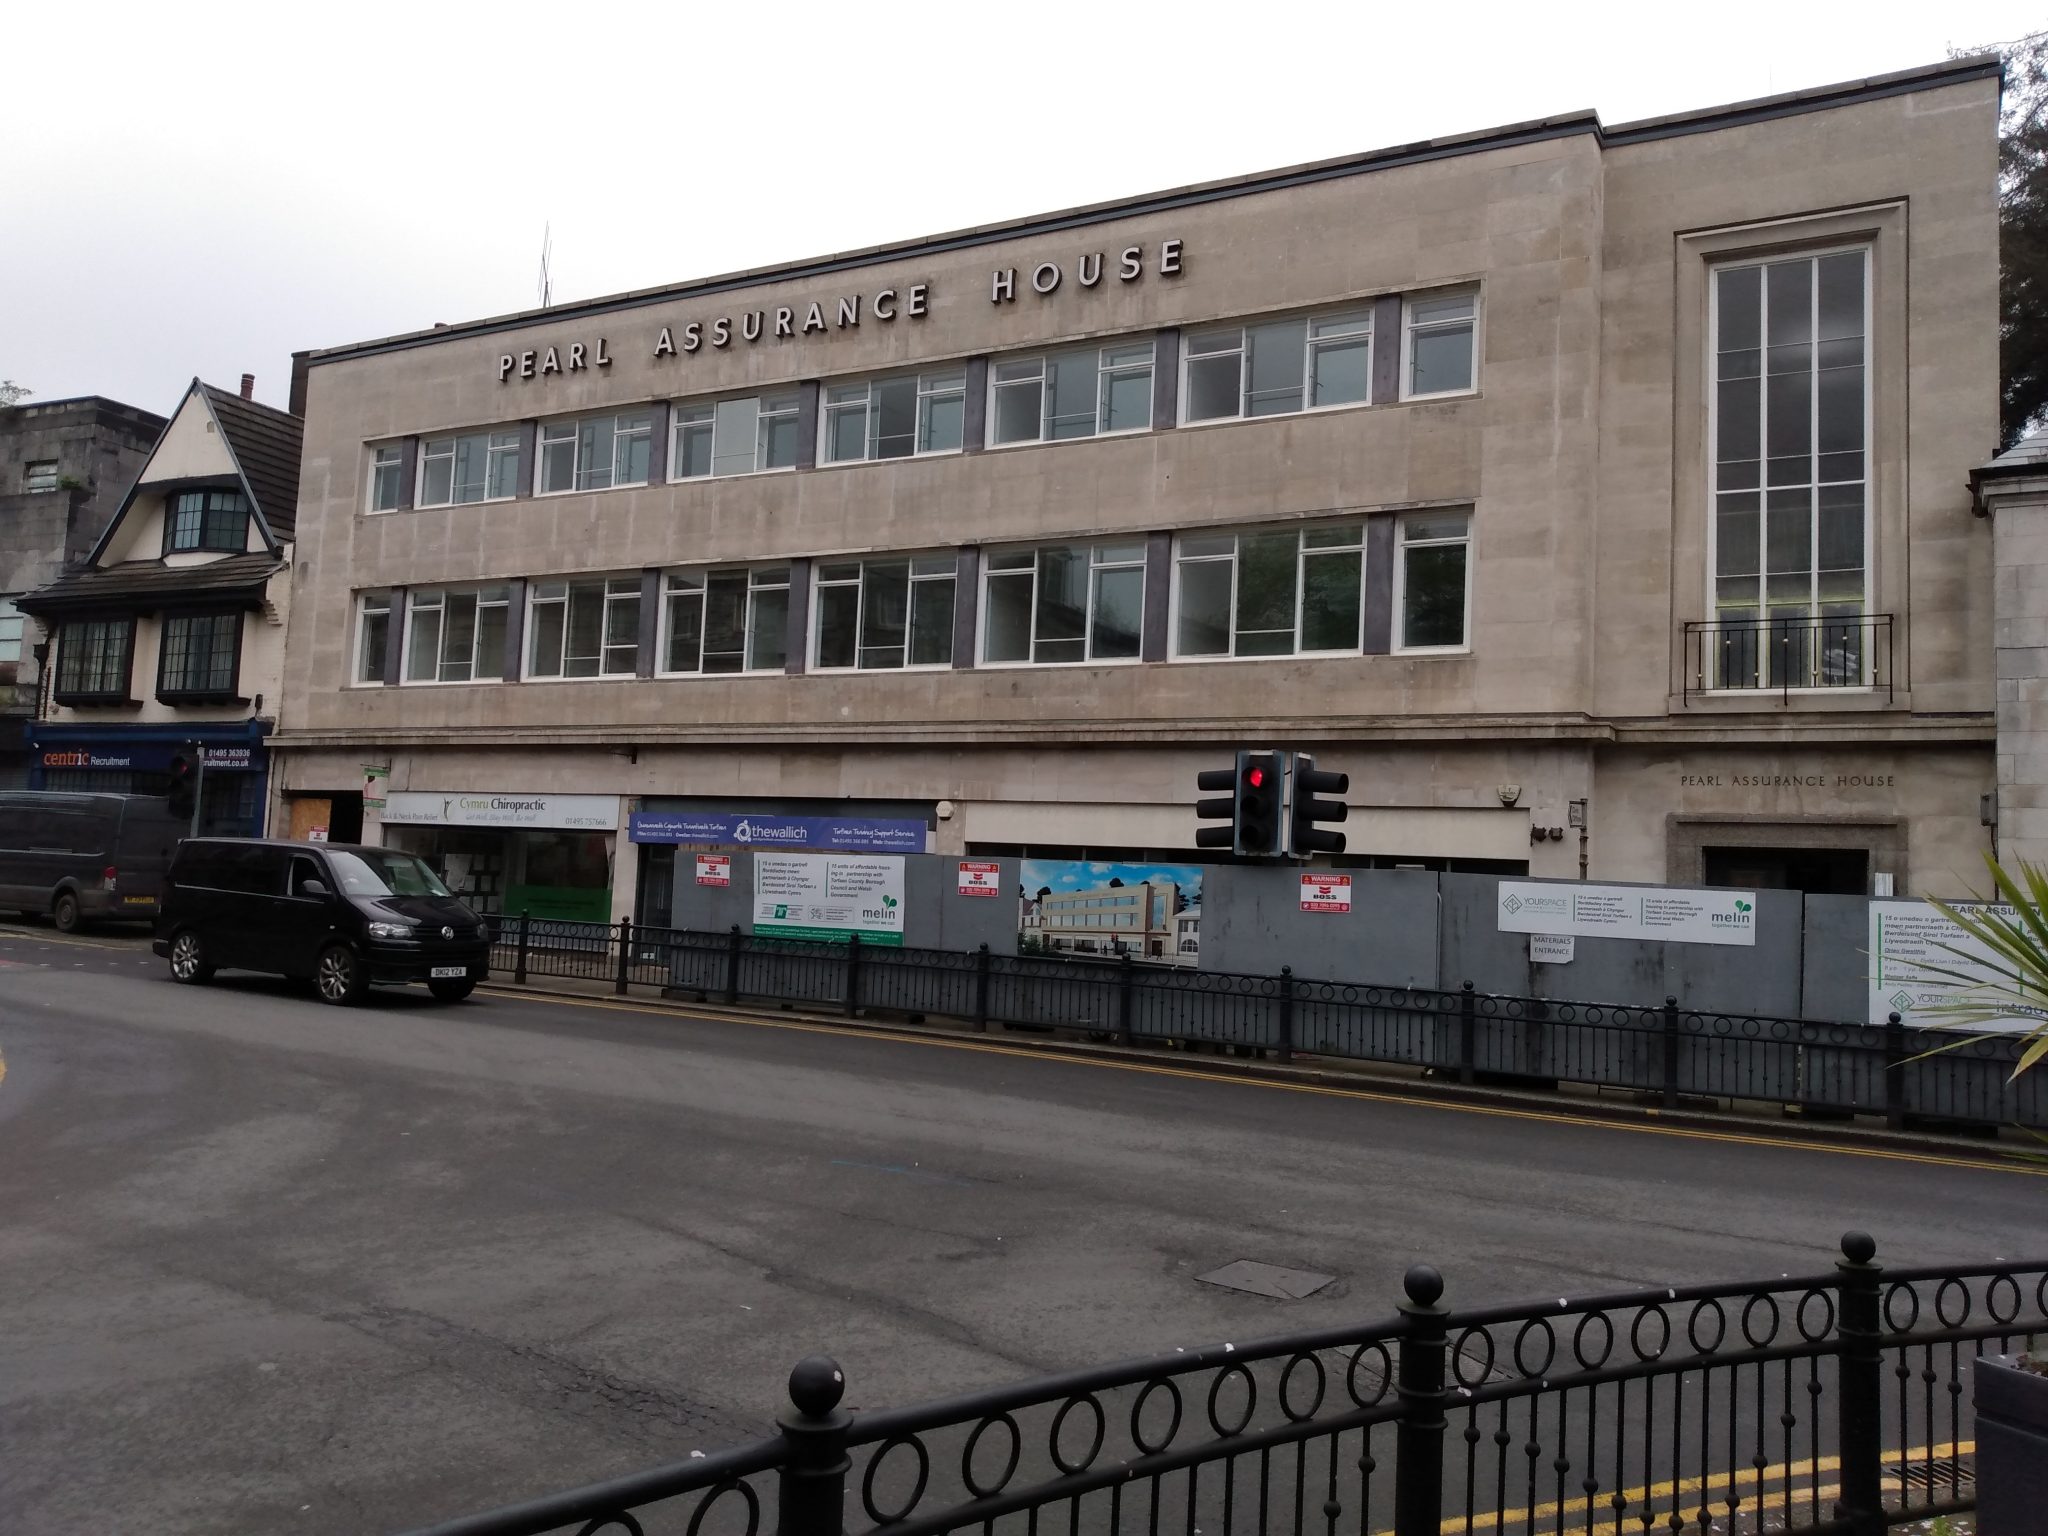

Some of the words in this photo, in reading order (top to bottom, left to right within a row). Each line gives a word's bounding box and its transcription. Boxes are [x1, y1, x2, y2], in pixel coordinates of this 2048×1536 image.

[498, 337, 612, 381] PEARL
[654, 284, 929, 357] ASSURANCE
[990, 238, 1186, 303] HOUSE
[43, 751, 90, 766] centric
[91, 756, 130, 766] Recruitment
[208, 749, 227, 757] 01495
[1681, 775, 1722, 787] PEARL
[1732, 775, 1825, 787] ASSURANCE
[1837, 775, 1894, 787] HOUSE
[460, 797, 489, 810] Cymru
[491, 797, 546, 814] Chiropractic
[752, 826, 807, 839] thewallich
[874, 828, 894, 838] Support
[1311, 875, 1341, 883] WARNING
[1524, 897, 1568, 907] YOURSPACE
[862, 908, 896, 920] melin
[1711, 912, 1750, 924] melin
[1534, 936, 1571, 945] MATERIALS
[1534, 946, 1570, 955] ENTRANCE
[435, 968, 450, 976] DK12
[451, 968, 462, 976] YZA
